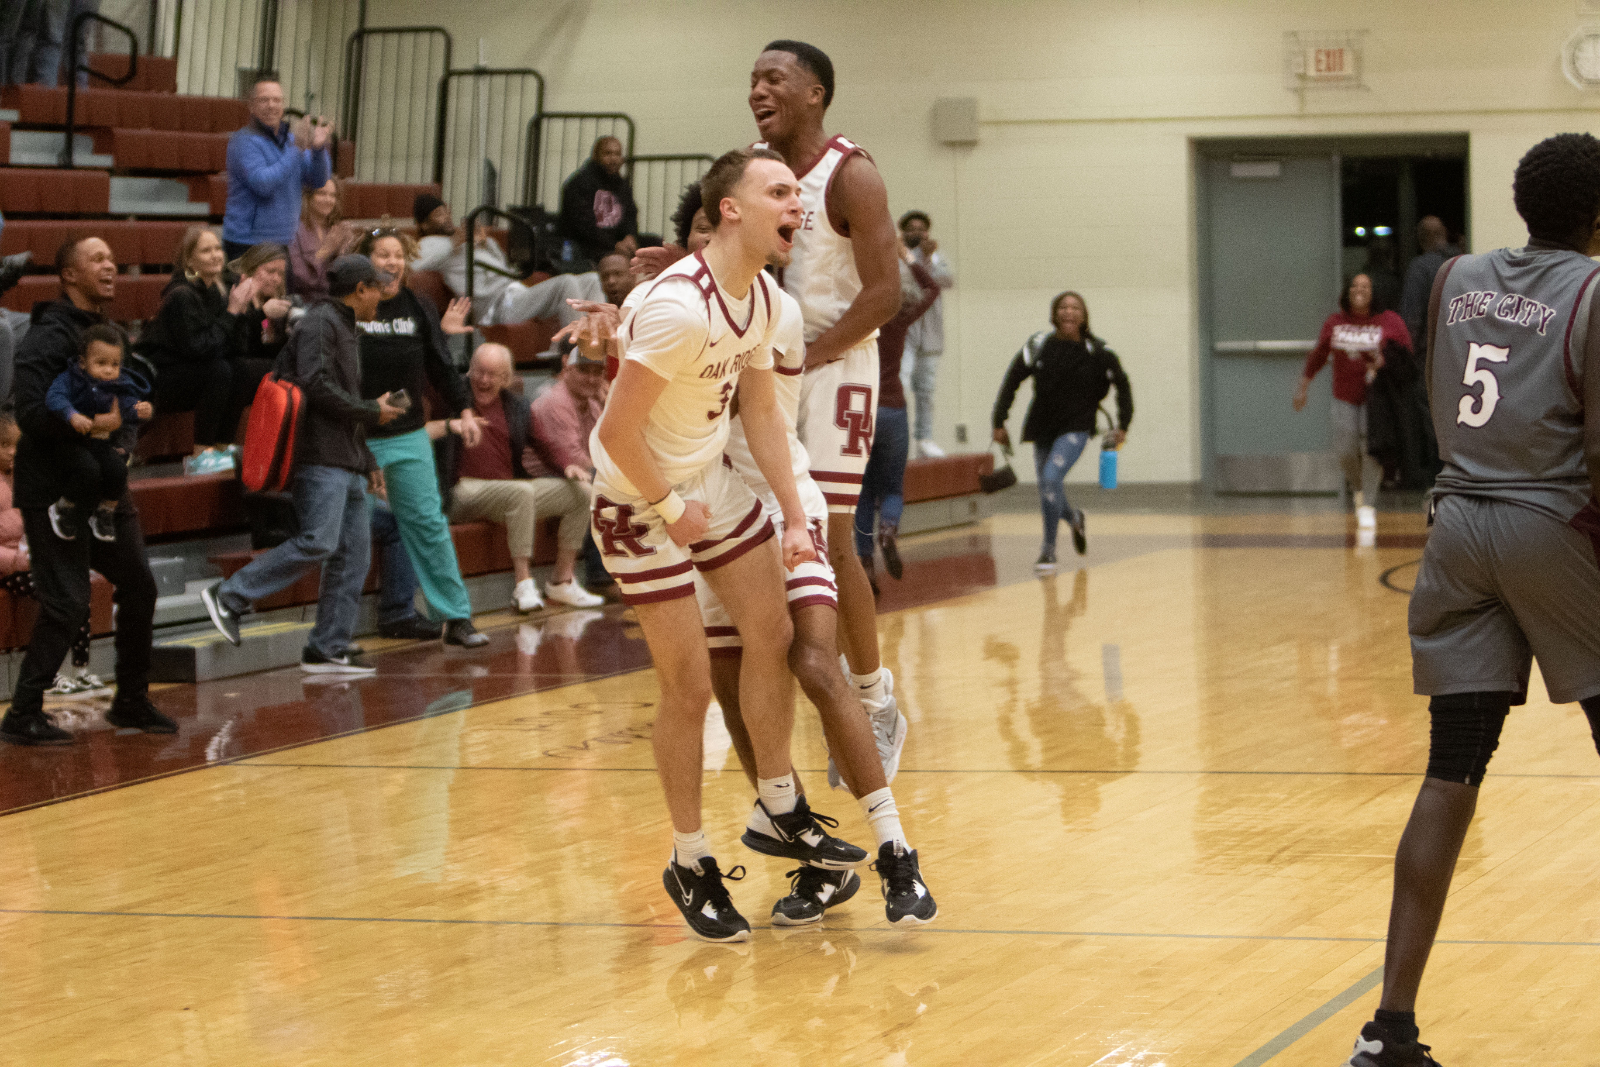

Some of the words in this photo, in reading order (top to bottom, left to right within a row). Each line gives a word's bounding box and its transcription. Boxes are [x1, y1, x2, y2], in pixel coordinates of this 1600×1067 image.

[1314, 47, 1345, 73] EXIT
[1446, 290, 1498, 326] THE
[1495, 293, 1557, 336] CITY
[699, 357, 731, 379] OAK
[1456, 340, 1512, 429] 5
